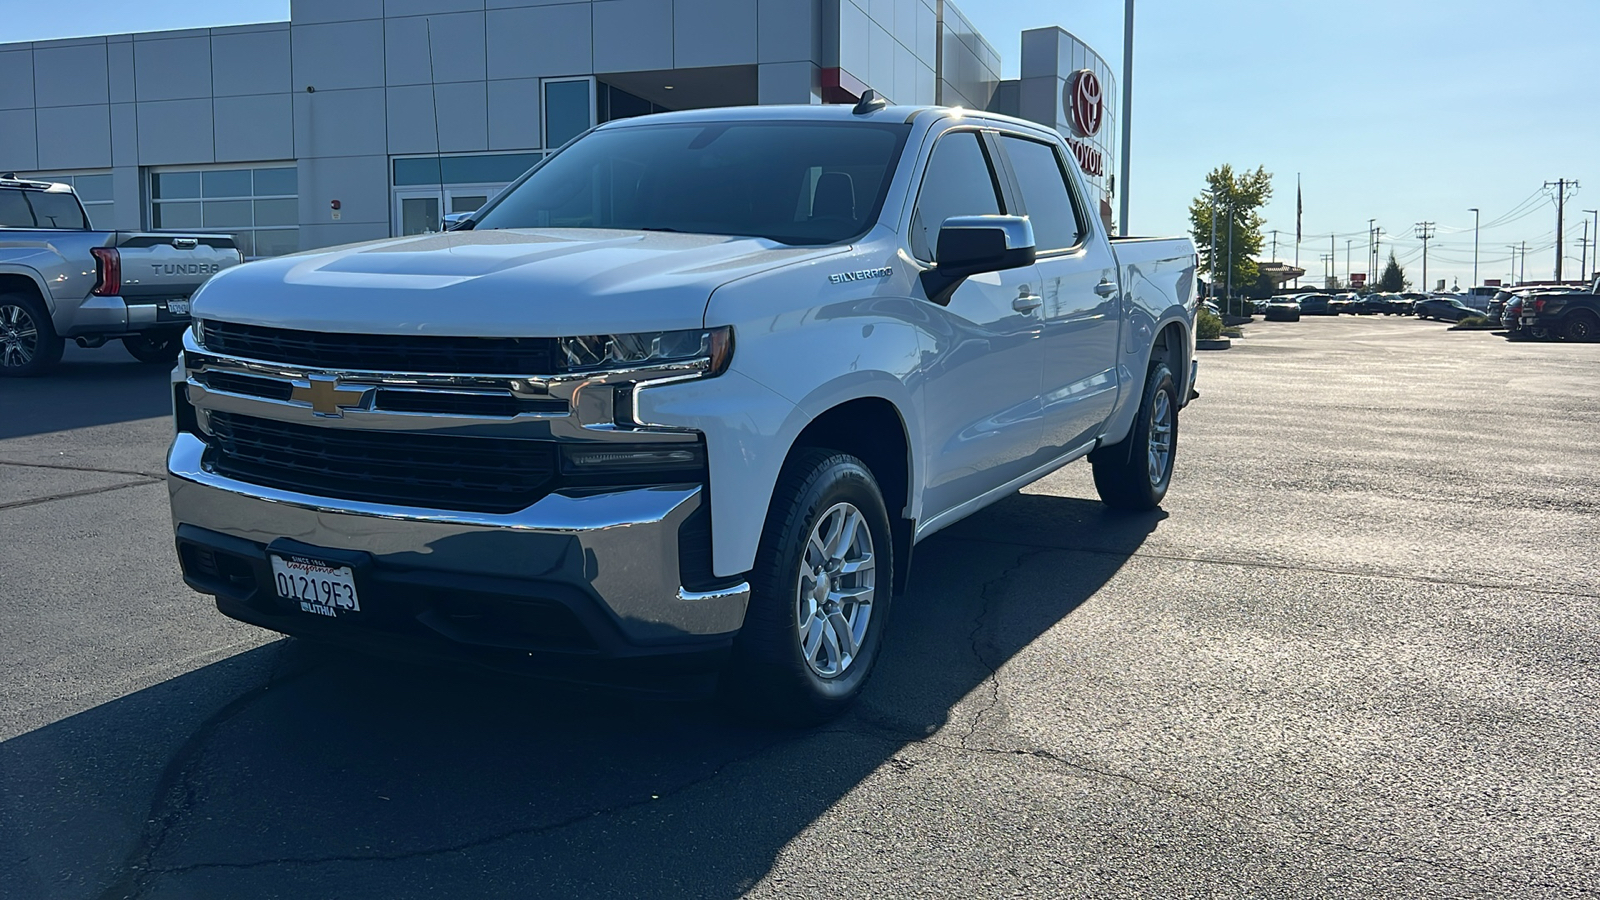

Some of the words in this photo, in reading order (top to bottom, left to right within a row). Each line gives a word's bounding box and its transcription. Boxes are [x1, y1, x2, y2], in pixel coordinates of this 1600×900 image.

[1067, 138, 1104, 174] TOYOTA
[151, 263, 220, 276] TUNDRA
[828, 266, 893, 284] SILVERADO
[291, 555, 311, 565] SINCE
[286, 561, 341, 576] California
[277, 572, 355, 610] 01219E3
[308, 602, 337, 618] LITHIA
